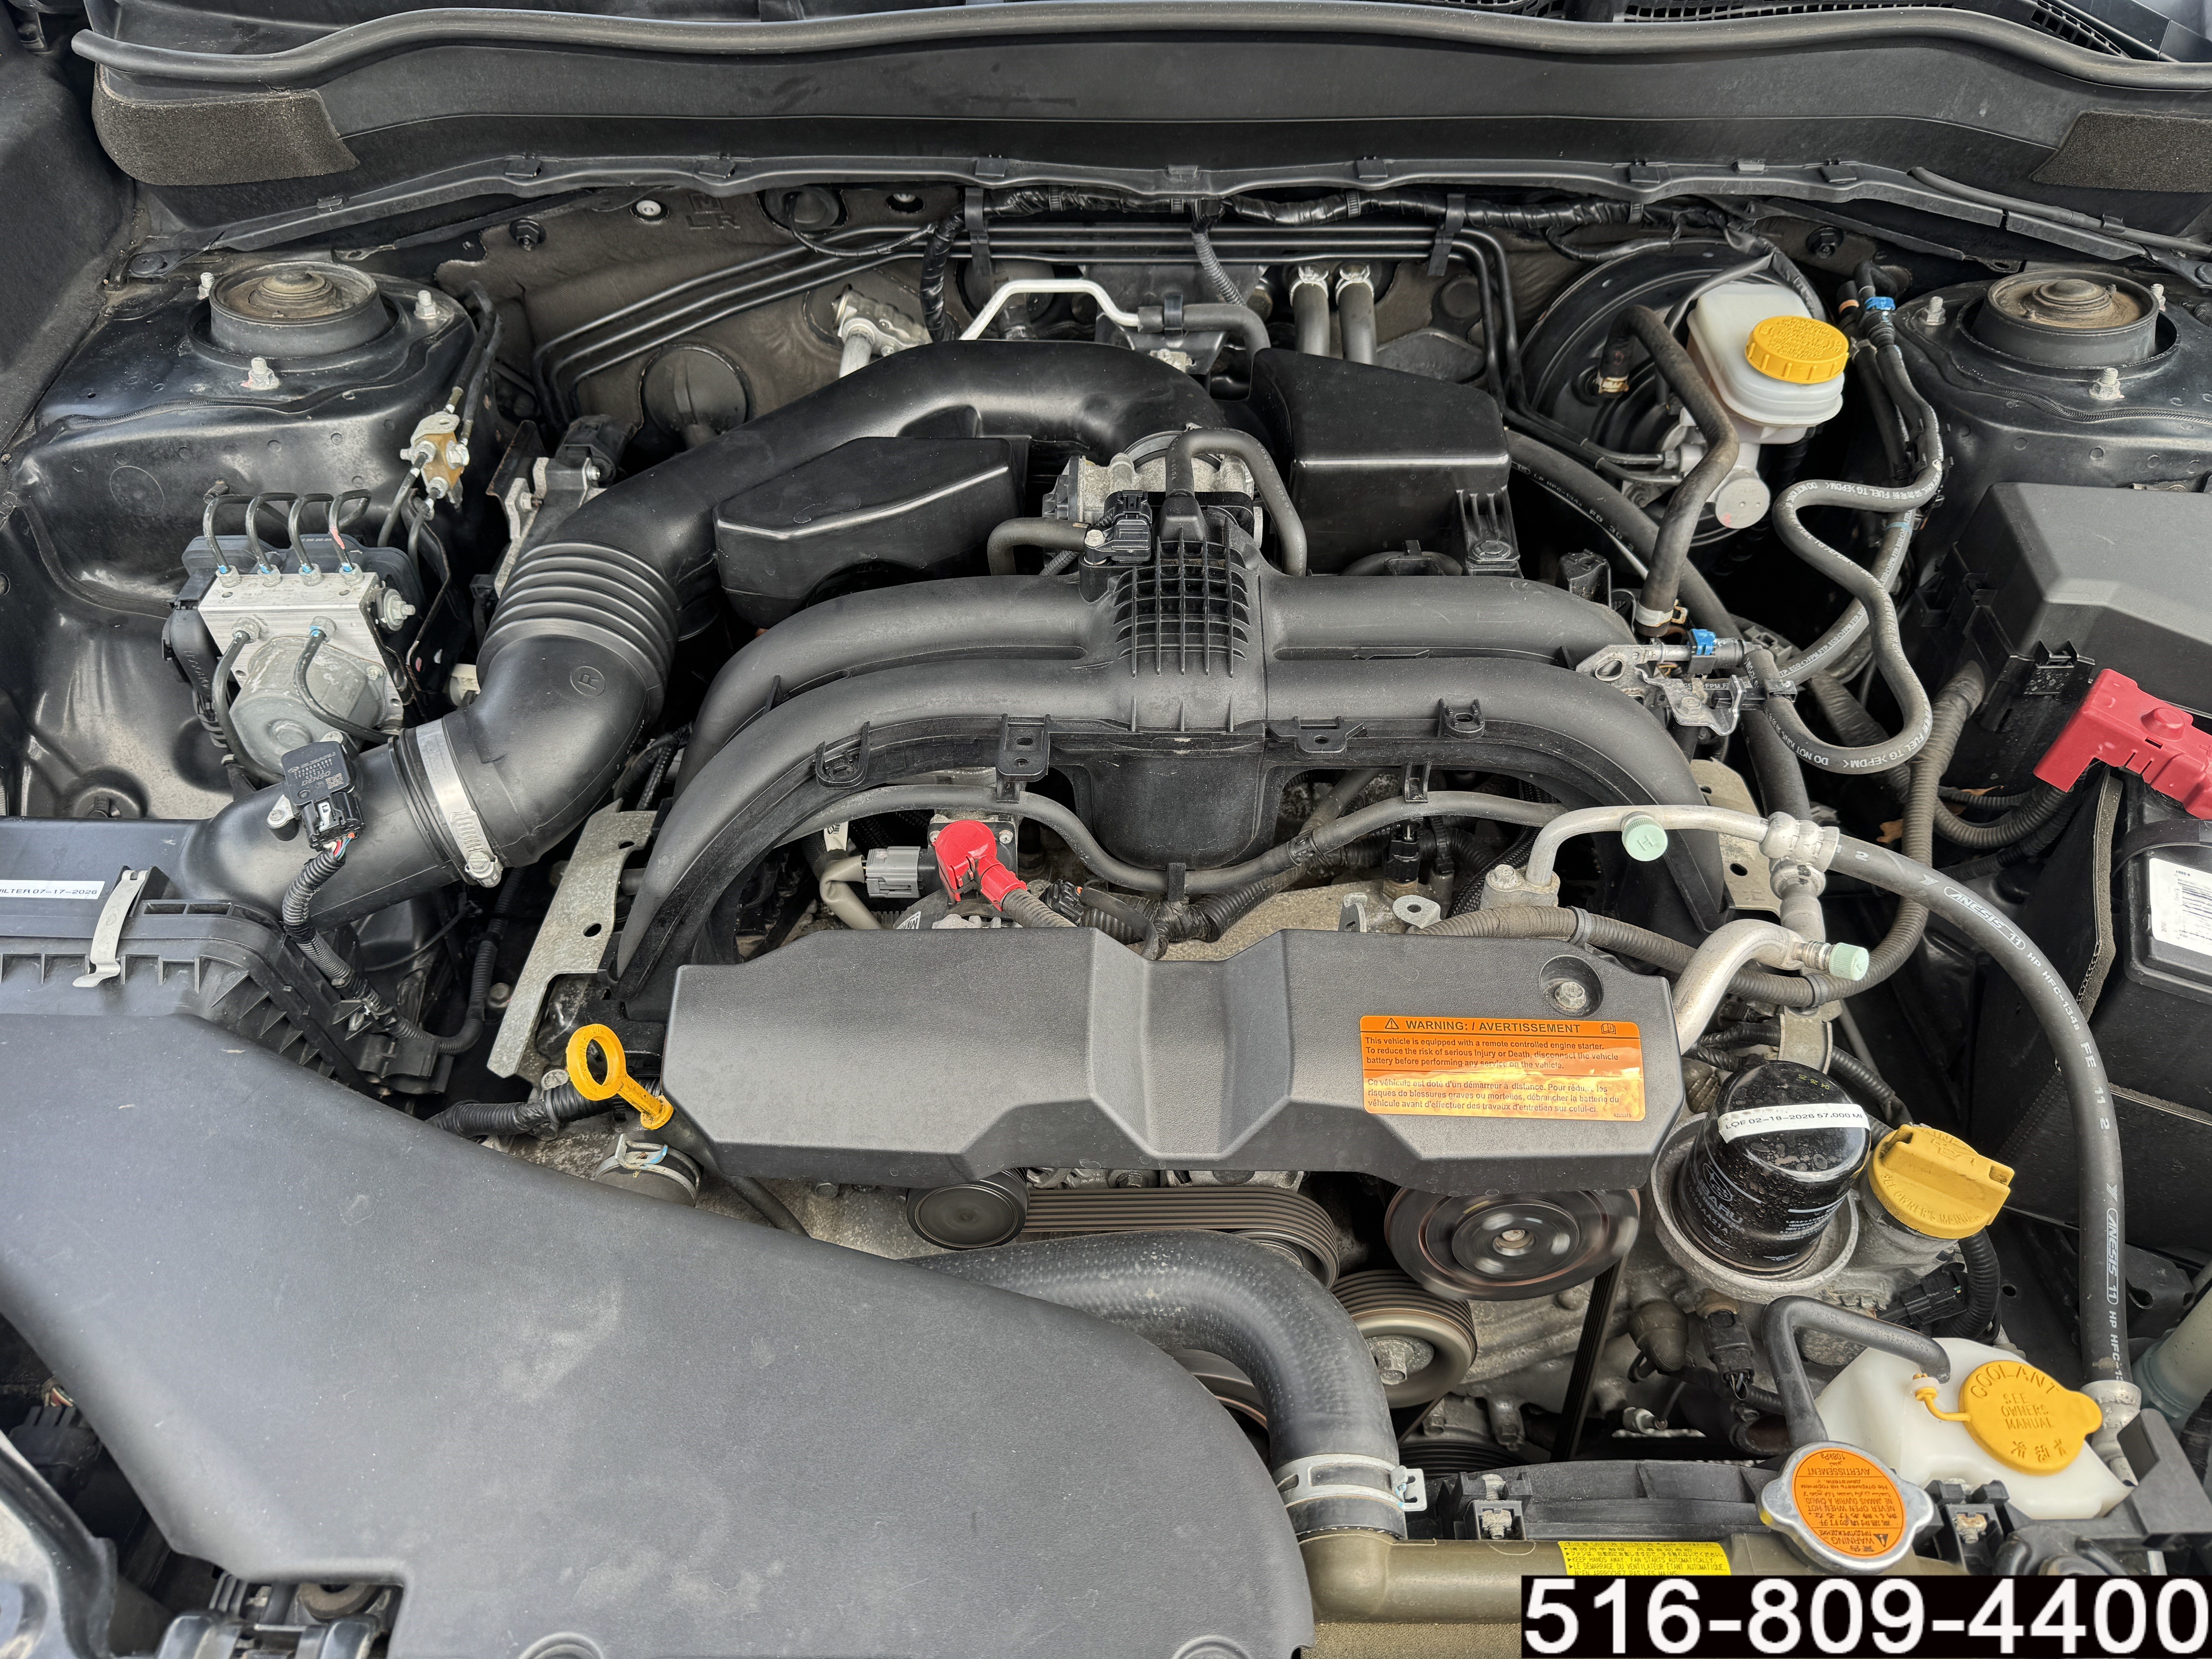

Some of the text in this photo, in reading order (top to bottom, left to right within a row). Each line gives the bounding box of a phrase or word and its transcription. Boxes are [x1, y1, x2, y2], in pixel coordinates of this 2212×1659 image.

[1870, 488, 1889, 499] FUEL
[576, 673, 601, 689] R
[1907, 734, 1925, 752] FUEL
[1796, 746, 1829, 766] DO NOT
[301, 771, 331, 787] DENSO
[1637, 835, 1655, 851] H
[2027, 952, 2042, 967] HP
[2042, 970, 2081, 1031] HFC-134a
[1406, 1020, 1580, 1033] WARNING: / AVERTISSEMENT
[1421, 1038, 1456, 1047] equipped
[1482, 1039, 1508, 1048] remote
[1550, 1042, 1576, 1050] engine
[1508, 1050, 1532, 1058] Death,
[1534, 1051, 1576, 1059] disconnect
[2080, 1042, 2097, 1068] FE
[1367, 1056, 1393, 1066] battery
[1421, 1058, 1463, 1068] performing
[1464, 1081, 1502, 1091] démarreur
[1511, 1082, 1546, 1091] distance.
[1368, 1089, 1396, 1099] risques
[1488, 1092, 1525, 1101] mortelles,
[1527, 1093, 1568, 1102] débrancher
[2094, 1086, 2106, 1104] 11
[1368, 1099, 1400, 1107] véhicule
[1424, 1101, 1465, 1109] d'effectuer
[1482, 1102, 1511, 1110] travaux
[1512, 1103, 1553, 1111] d'entretien
[2099, 1117, 2110, 1130] 2
[2109, 1310, 2118, 1328] HP
[1970, 1364, 2059, 1399] COOLANT
[2003, 1393, 2028, 1405] SEE
[2001, 1404, 2049, 1417] OWNERS
[2005, 1417, 2053, 1430] MANUAL
